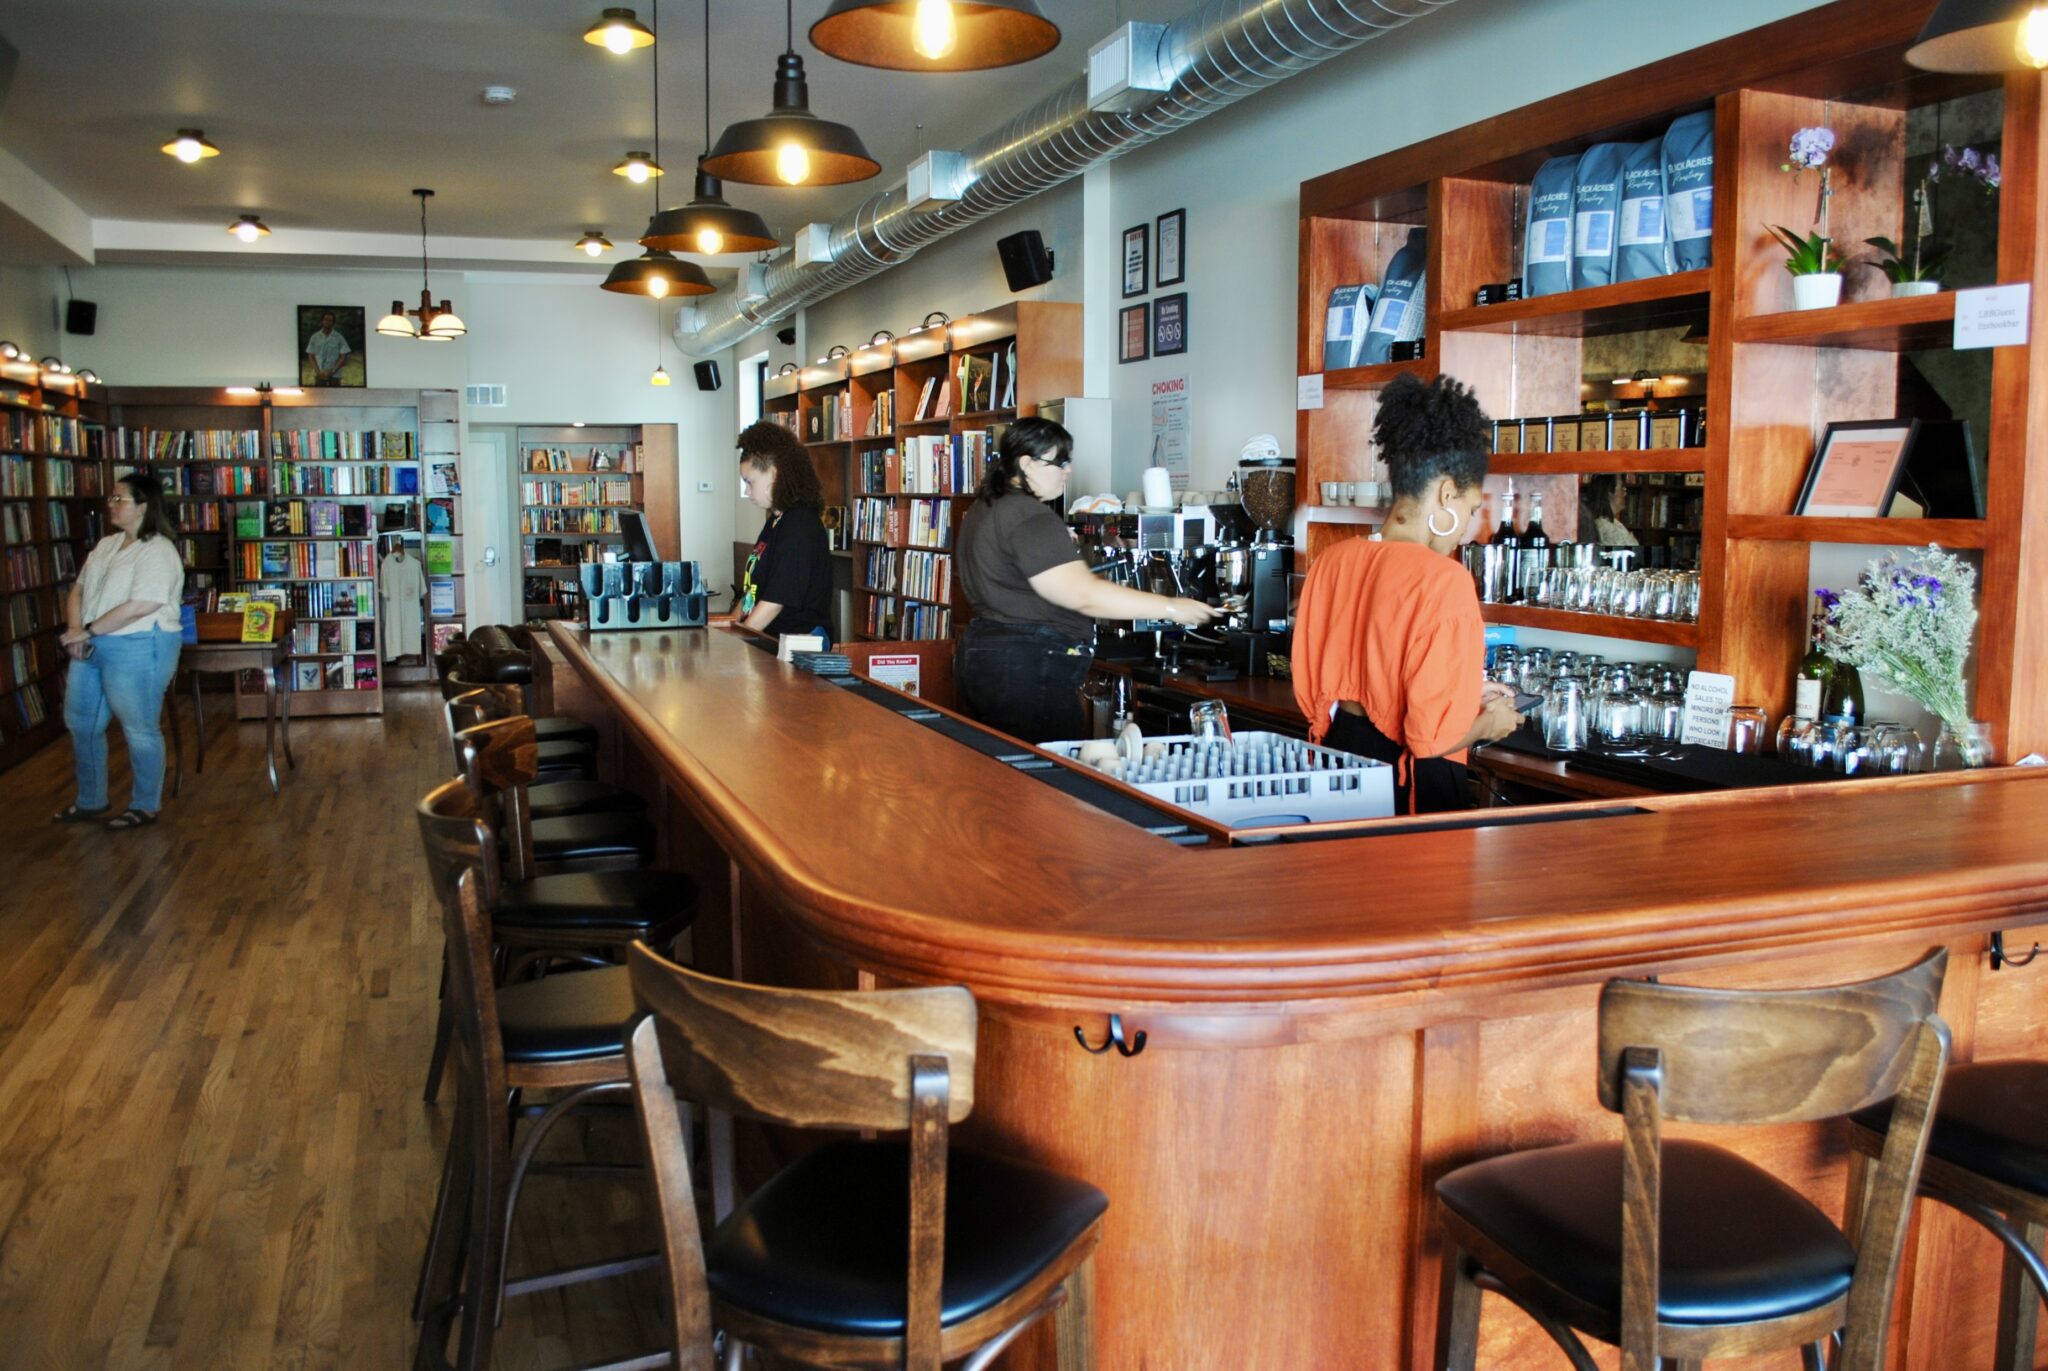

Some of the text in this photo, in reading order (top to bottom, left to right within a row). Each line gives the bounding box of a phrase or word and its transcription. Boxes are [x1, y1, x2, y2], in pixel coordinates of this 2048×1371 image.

[1686, 156, 1713, 169] ACRES
[1592, 183, 1615, 192] ACRES
[1547, 192, 1568, 202] ACRES
[1152, 378, 1184, 395] CHOKING
[1701, 685, 1728, 695] ALCOHOL
[1694, 694, 1723, 705] SALES TO
[1691, 704, 1713, 713] MINORS
[1692, 714, 1720, 725] PERSONS
[1689, 725, 1720, 736] WHO LOOK
